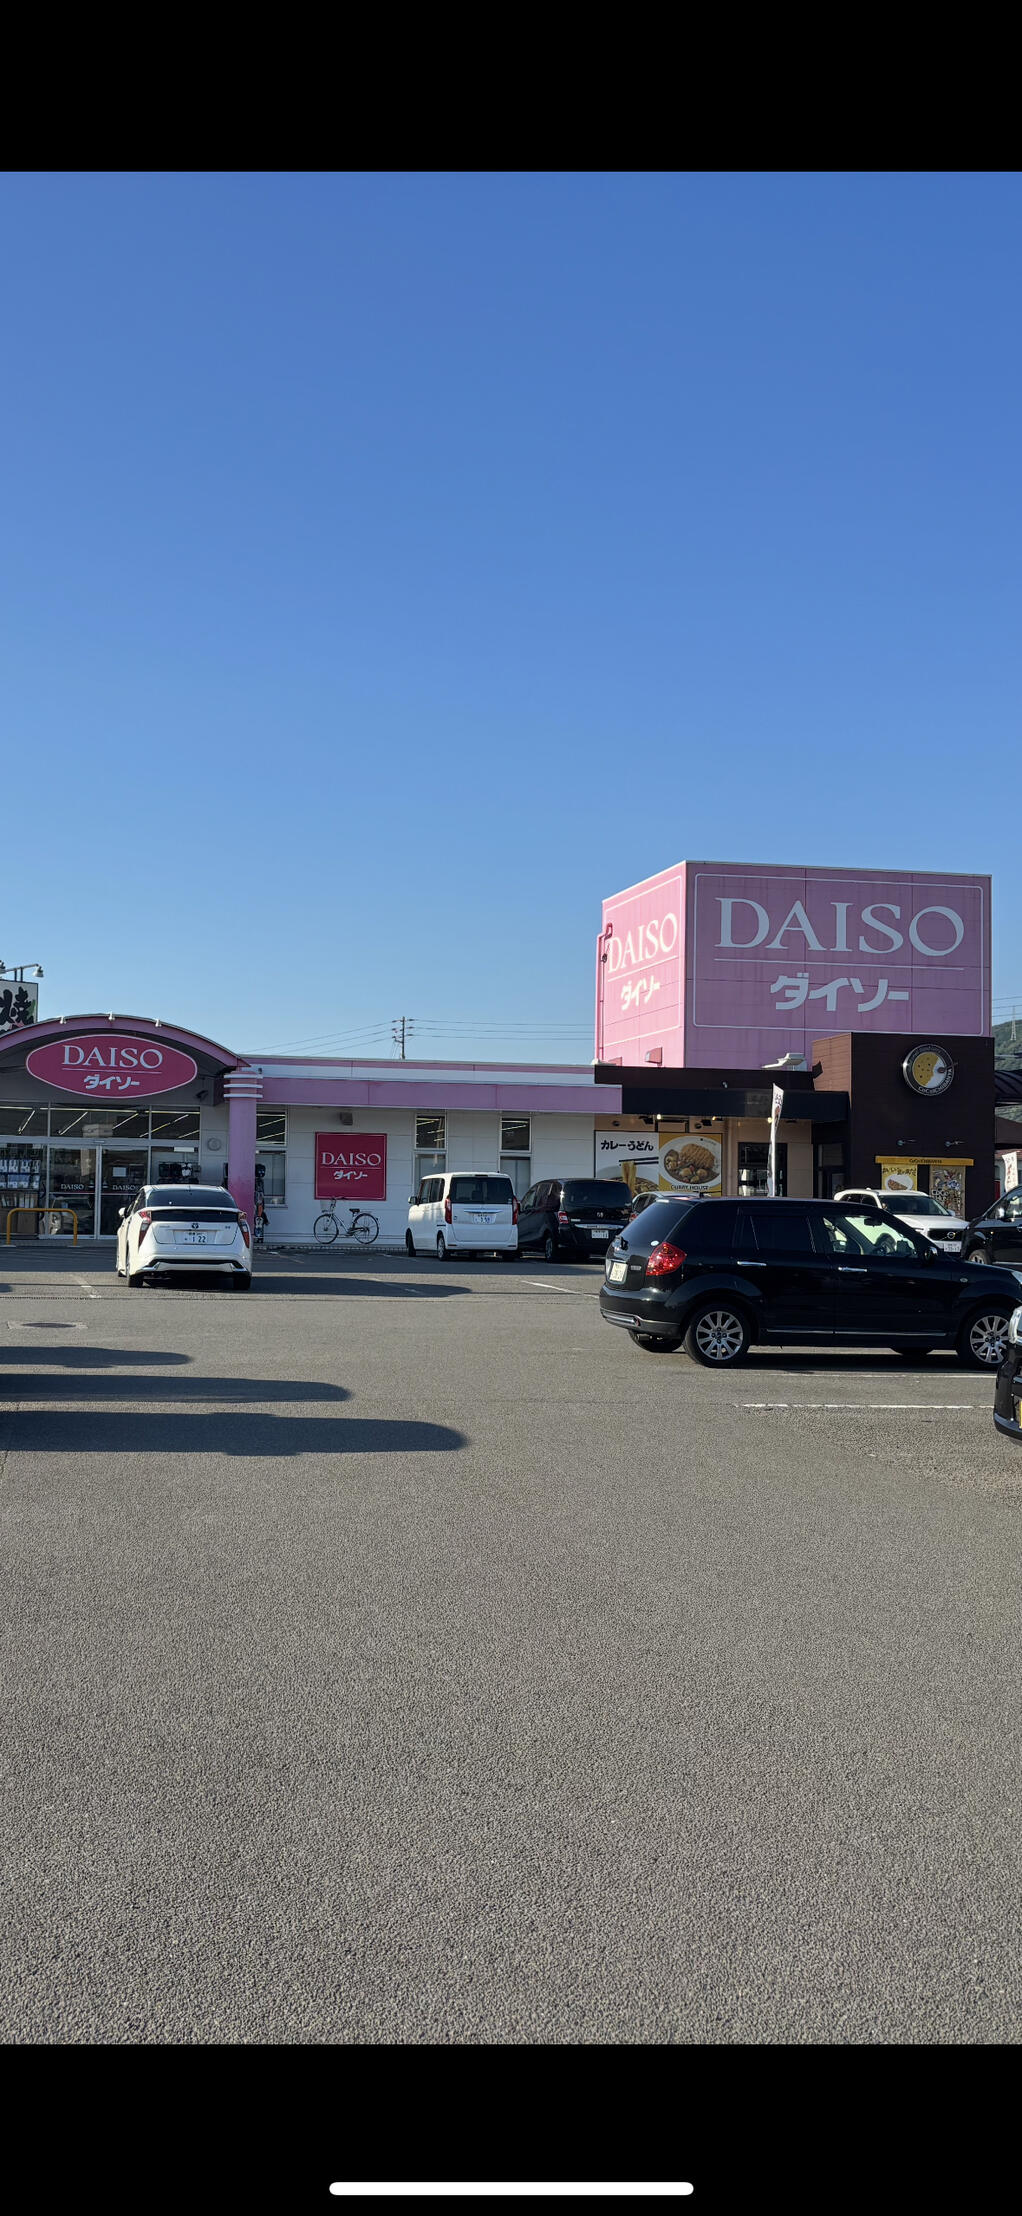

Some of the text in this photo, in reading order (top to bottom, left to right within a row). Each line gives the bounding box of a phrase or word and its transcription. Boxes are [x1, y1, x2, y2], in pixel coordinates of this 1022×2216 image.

[714, 897, 965, 957] DAISO
[607, 912, 679, 974] DAISO
[620, 978, 661, 1012] ダイソー
[770, 972, 909, 1012] ダイソー
[62, 1045, 163, 1069] DAISO
[83, 1074, 140, 1090] ダイソー
[601, 1140, 654, 1151] カレーうどん
[320, 1151, 382, 1166] DAISO
[333, 1169, 368, 1180] ダイソー
